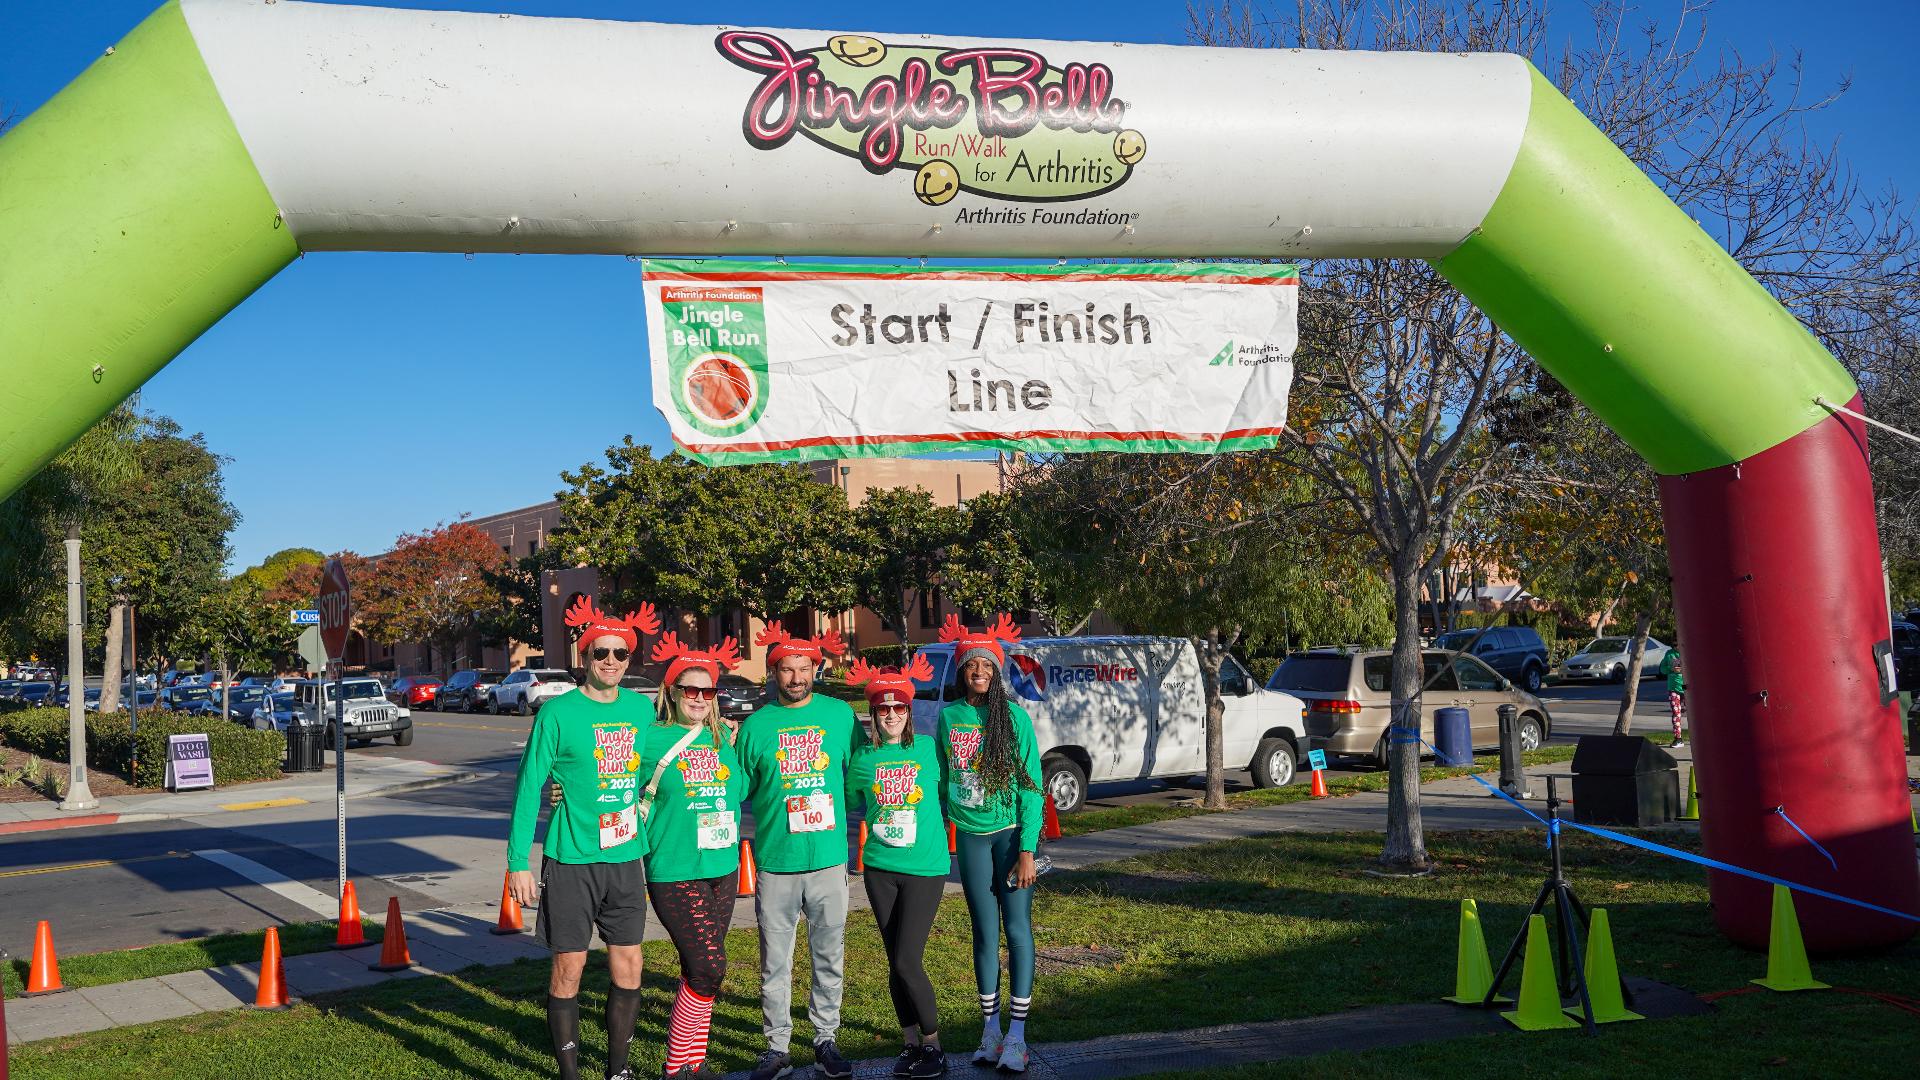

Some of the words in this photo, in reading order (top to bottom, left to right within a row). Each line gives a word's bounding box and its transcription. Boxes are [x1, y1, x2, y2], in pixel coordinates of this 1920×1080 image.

[715, 30, 969, 175] Jingle
[934, 47, 1126, 138] Bell
[915, 133, 1007, 158] Run/Walk
[975, 162, 996, 182] for
[1006, 149, 1113, 183] Arthritis
[955, 207, 1026, 224] Arthritis
[666, 290, 703, 299] Arthritis
[705, 291, 758, 300] Foundation
[678, 304, 744, 328] Jingle
[831, 302, 952, 346] Start
[972, 301, 993, 350] /
[1014, 302, 1152, 345] Finish
[672, 328, 712, 347] Bell
[717, 328, 760, 347] Run
[1238, 343, 1280, 355] Arthritis
[1238, 354, 1293, 367] Foundatio
[947, 368, 1053, 412] Line
[321, 590, 348, 630] STOP
[1049, 663, 1139, 686] RaceWire
[595, 726, 635, 747] Jingle
[778, 729, 823, 749] Jingle
[177, 742, 204, 752] DOG
[178, 750, 205, 760] WASH
[604, 743, 634, 761] Bell
[788, 744, 820, 762] Bell
[597, 758, 625, 774] Run
[689, 757, 721, 770] Bell
[780, 759, 811, 774] Run
[682, 767, 714, 783] Run
[875, 763, 918, 782] Jingle
[610, 777, 636, 790] 2023
[794, 776, 826, 789] 2023
[883, 777, 914, 796] Bell
[699, 786, 727, 797] 2023
[875, 792, 904, 806] Run
[802, 811, 823, 825] 160
[614, 822, 630, 839] 162
[710, 827, 730, 841] 390
[883, 826, 904, 839] 388
